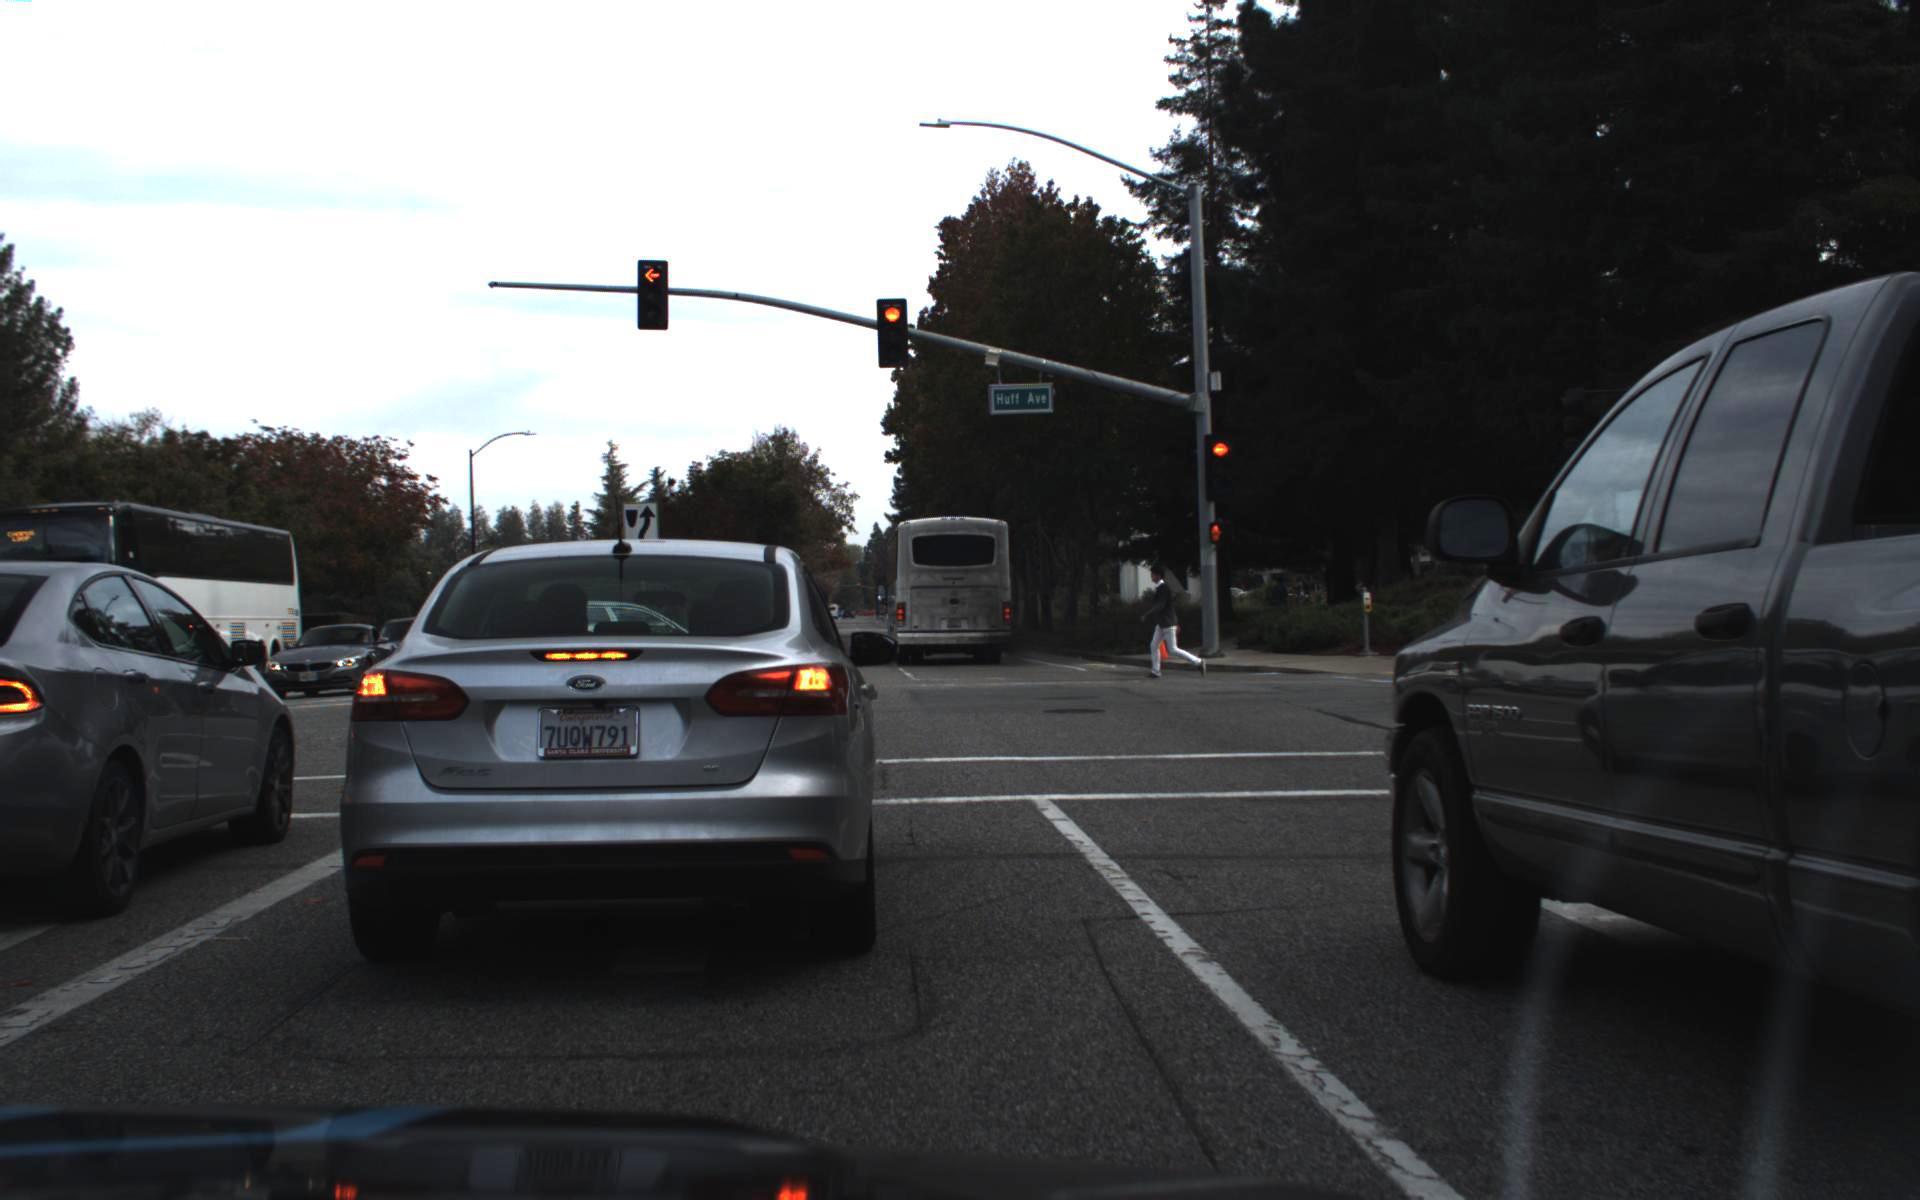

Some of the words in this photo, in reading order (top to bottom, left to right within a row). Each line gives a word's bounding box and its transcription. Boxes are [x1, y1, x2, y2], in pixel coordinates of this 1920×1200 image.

[996, 392, 1020, 405] Huff
[1027, 391, 1047, 405] Ave
[544, 725, 627, 748] 7UQW791
